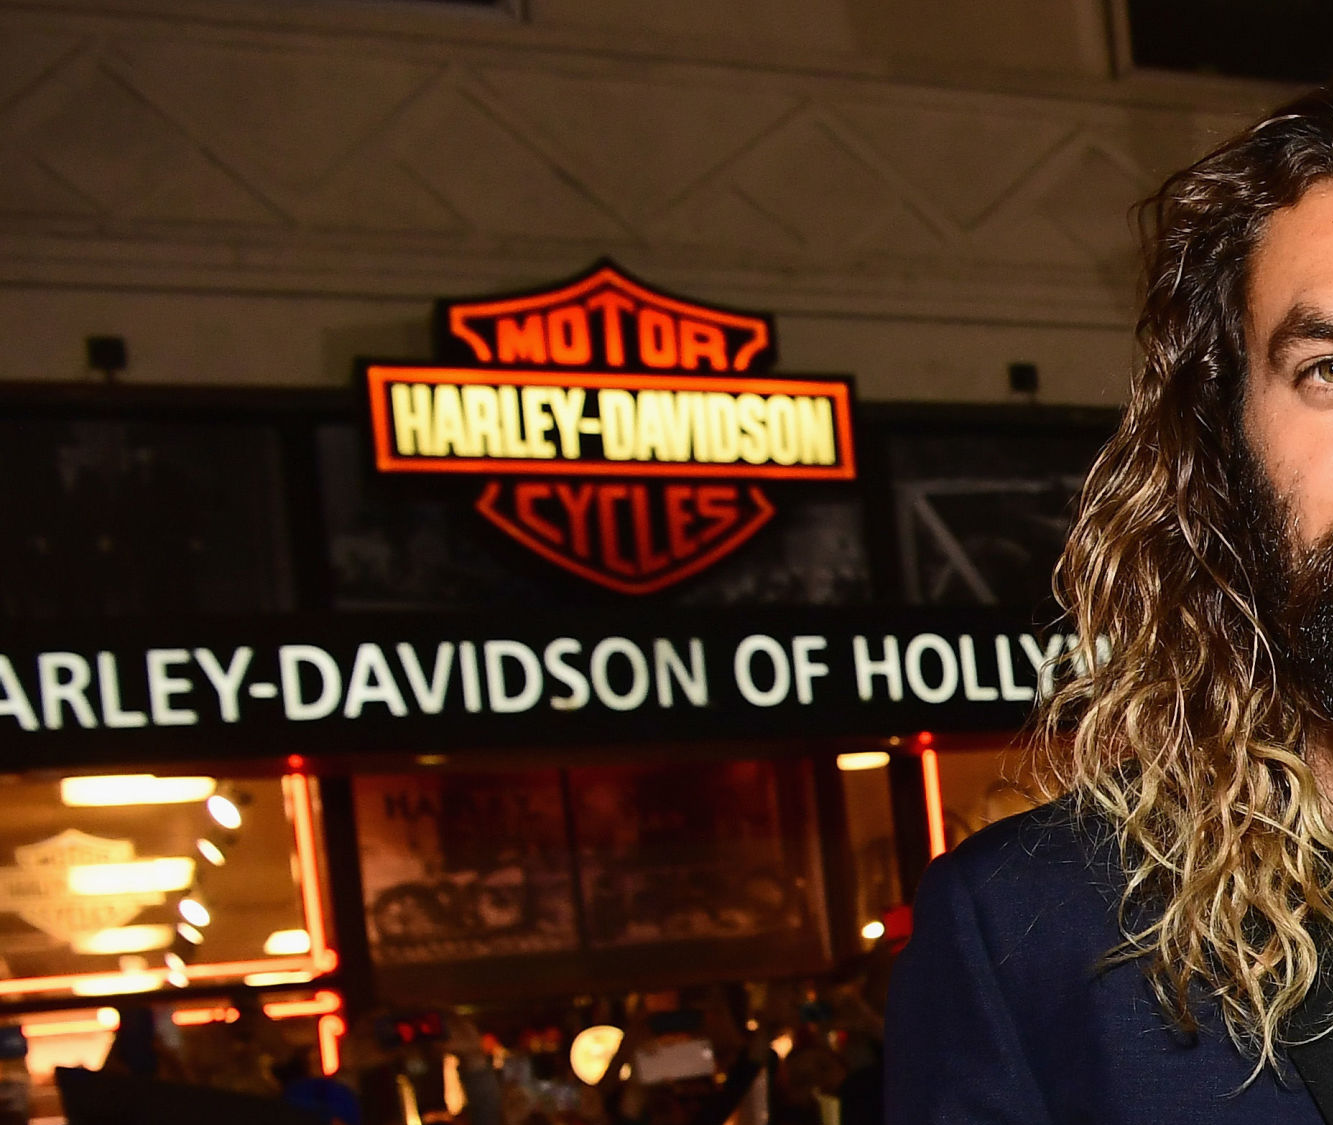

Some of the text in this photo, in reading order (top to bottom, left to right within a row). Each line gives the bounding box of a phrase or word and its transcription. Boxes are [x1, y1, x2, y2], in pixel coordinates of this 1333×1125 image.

[497, 291, 728, 371] MOTOR
[391, 383, 837, 466] HARLEY-DAVIDSON
[514, 482, 738, 576] CYCLES
[733, 632, 829, 708] OF
